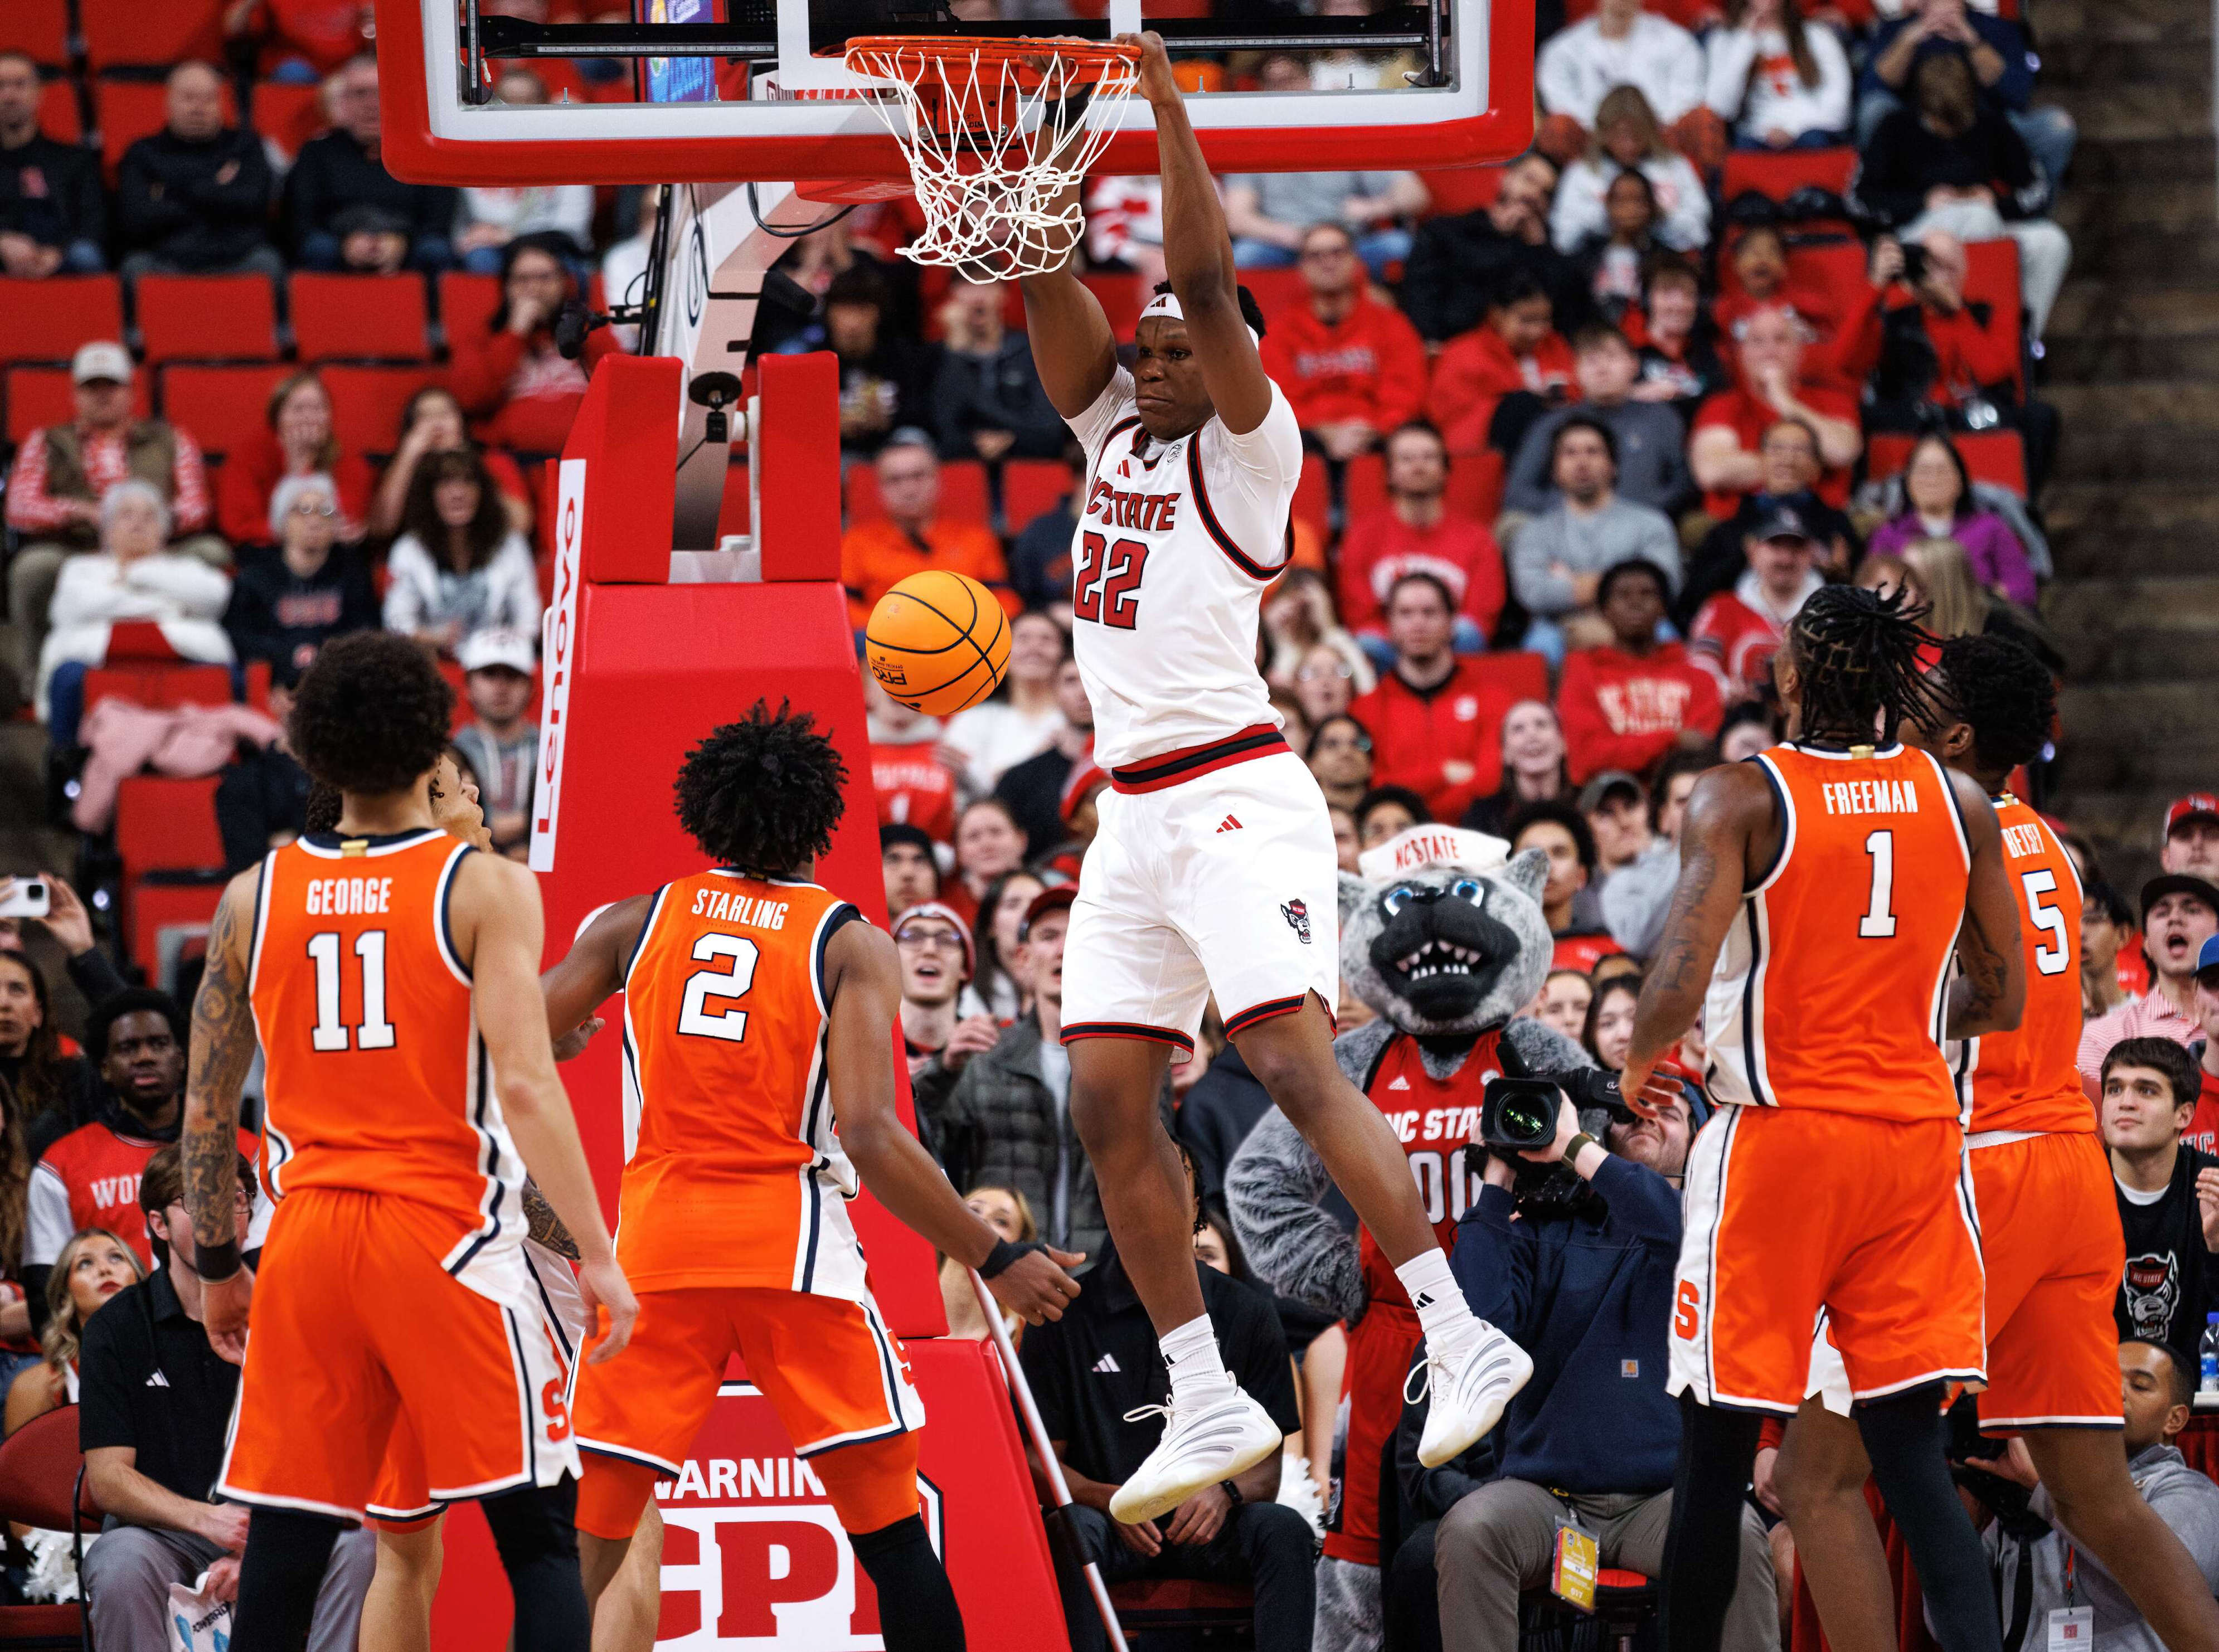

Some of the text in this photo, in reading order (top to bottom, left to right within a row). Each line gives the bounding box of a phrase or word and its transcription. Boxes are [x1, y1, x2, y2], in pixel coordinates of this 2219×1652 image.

[1074, 529, 1150, 630] 22
[537, 497, 575, 833] Lenovo
[872, 665, 907, 686] PRO
[1822, 780, 1918, 815] FREEMAN
[306, 877, 393, 915] GEORGE
[691, 888, 789, 931] STARLING
[1857, 829, 1897, 938] 1
[2021, 868, 2070, 976] 5
[307, 929, 397, 1053] 11
[677, 932, 760, 1043] 2
[1422, 1106, 1483, 1141] STA
[1675, 1279, 1700, 1341] S
[541, 1377, 570, 1442] S
